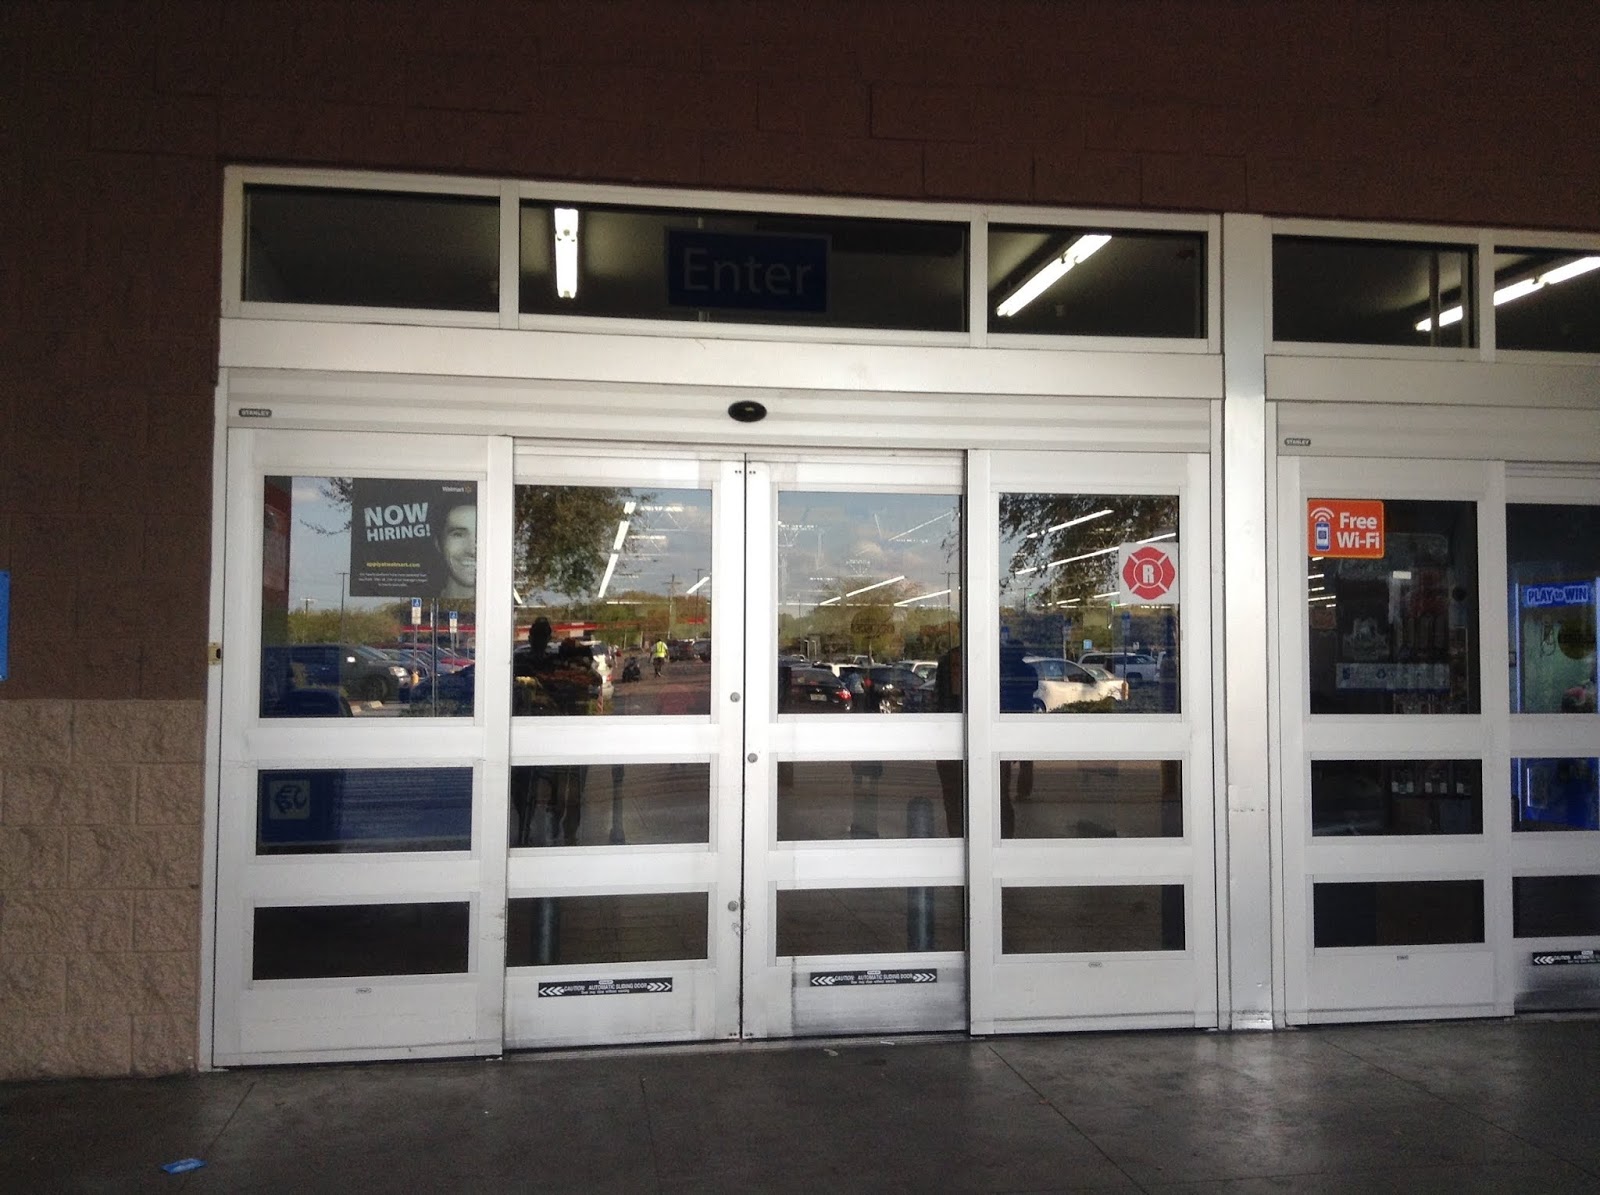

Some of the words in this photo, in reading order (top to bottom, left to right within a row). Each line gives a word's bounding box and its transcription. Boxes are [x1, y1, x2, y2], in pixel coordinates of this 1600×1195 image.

[683, 248, 814, 295] Enter
[364, 502, 429, 527] NOW
[1339, 512, 1378, 529] Free
[366, 524, 431, 542] HIRING!
[1336, 531, 1380, 549] Wi-Fi
[1142, 564, 1155, 584] R
[1527, 588, 1553, 604] PLAY
[1564, 586, 1588, 603] WIN
